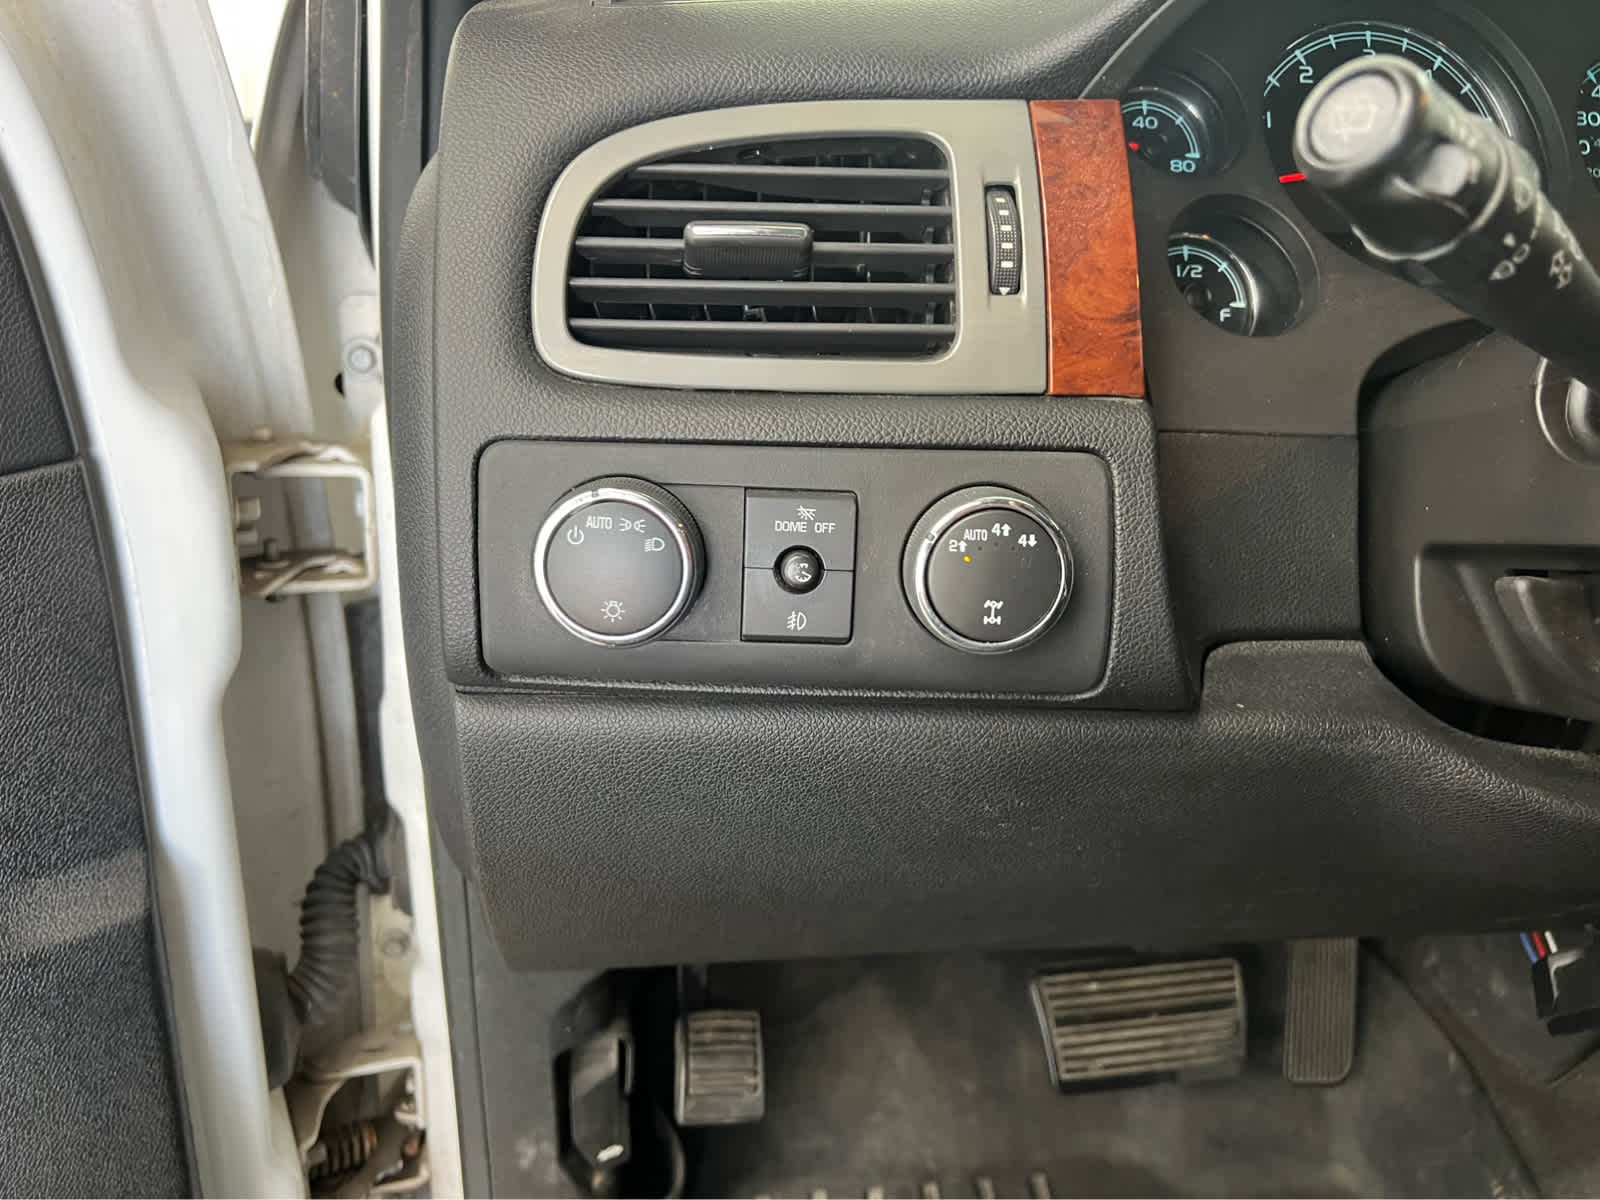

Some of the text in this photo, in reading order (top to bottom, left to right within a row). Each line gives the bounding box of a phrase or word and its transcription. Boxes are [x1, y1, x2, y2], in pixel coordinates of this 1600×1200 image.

[1299, 66, 1314, 83] 2
[1132, 116, 1158, 129] 40
[1170, 160, 1196, 173] 80
[1176, 265, 1203, 278] 1/2
[1219, 308, 1231, 322] F
[585, 516, 613, 530] AUTO
[774, 520, 837, 534] DOME OFF
[963, 529, 988, 542] AUTO
